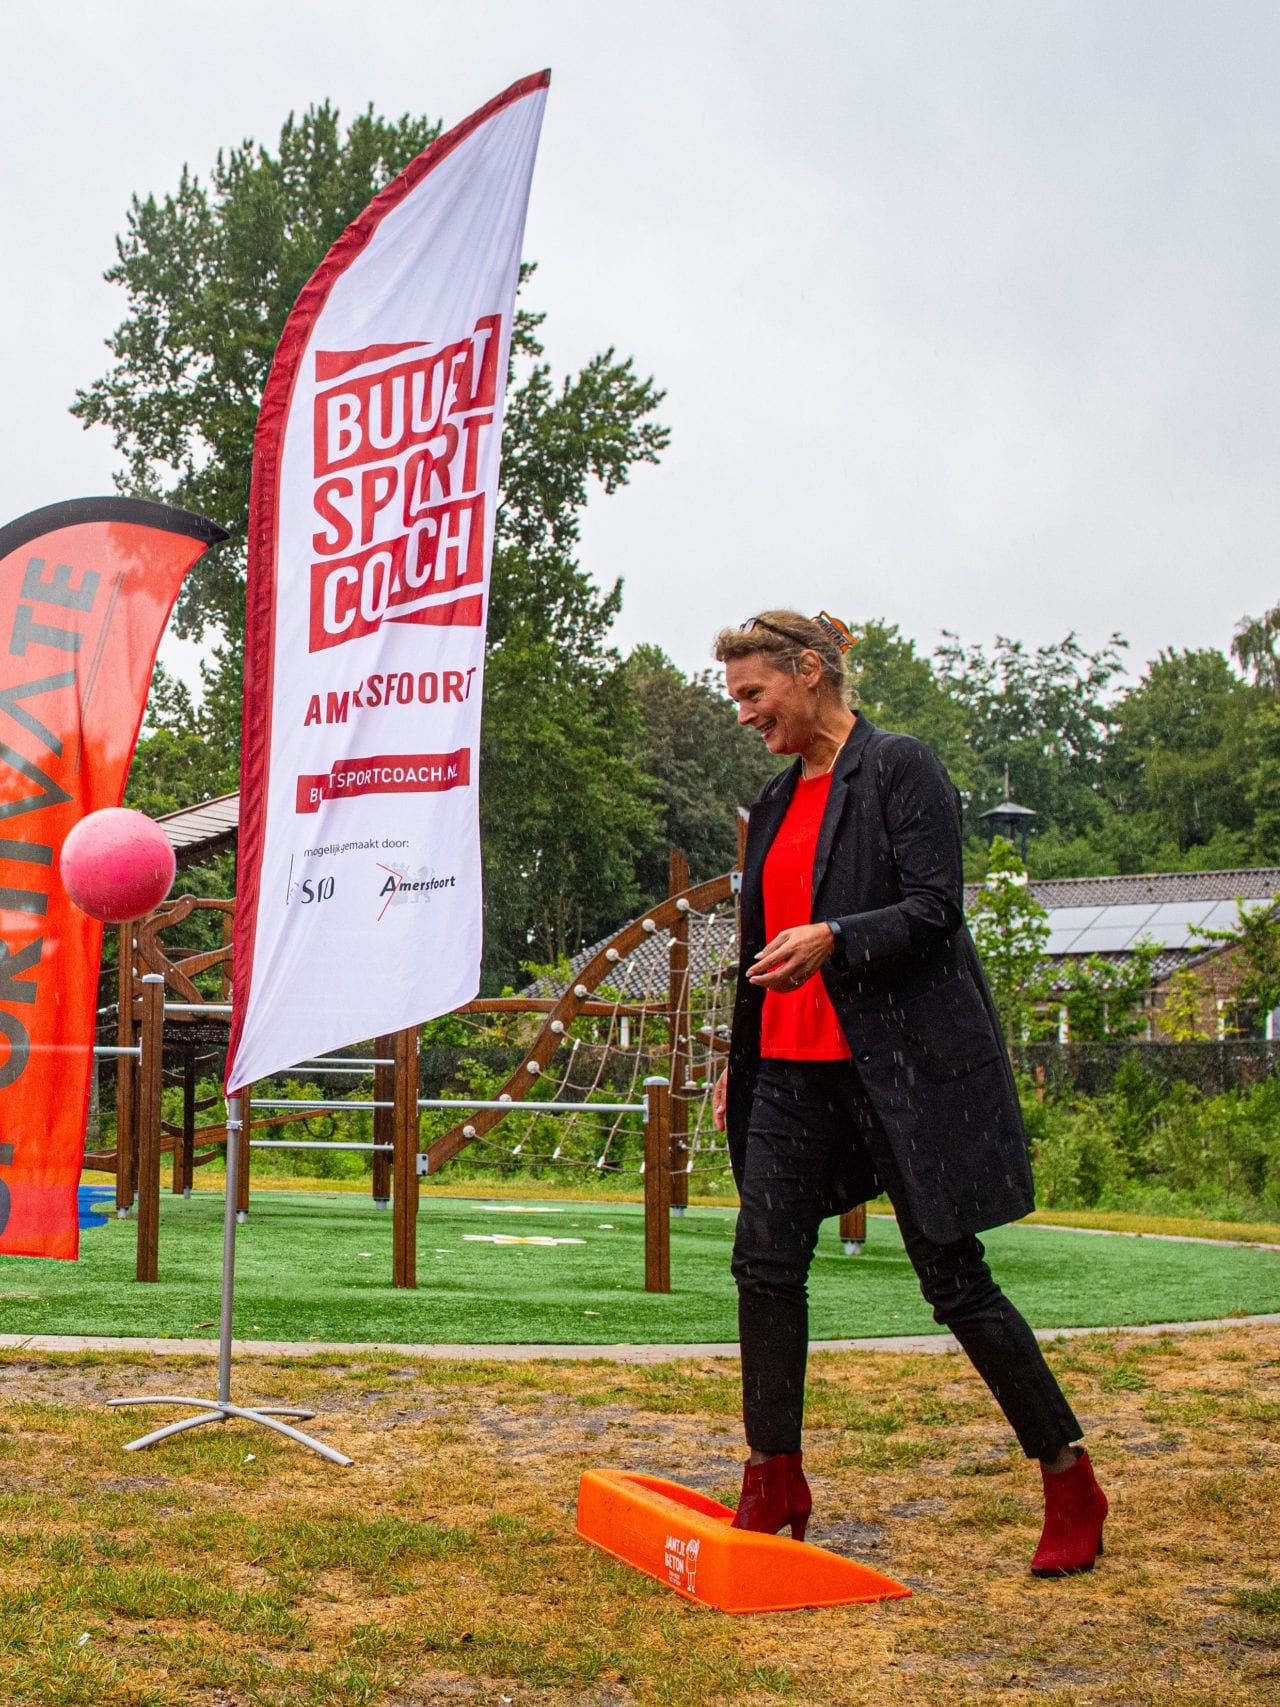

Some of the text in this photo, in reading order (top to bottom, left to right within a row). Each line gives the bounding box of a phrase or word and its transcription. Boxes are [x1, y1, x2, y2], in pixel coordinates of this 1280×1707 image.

[323, 508, 473, 635] COCH
[304, 667, 477, 727] AMSFOORT
[381, 838, 410, 849] door:
[379, 875, 457, 897] Amersfoort
[664, 1551, 685, 1575] BETON
